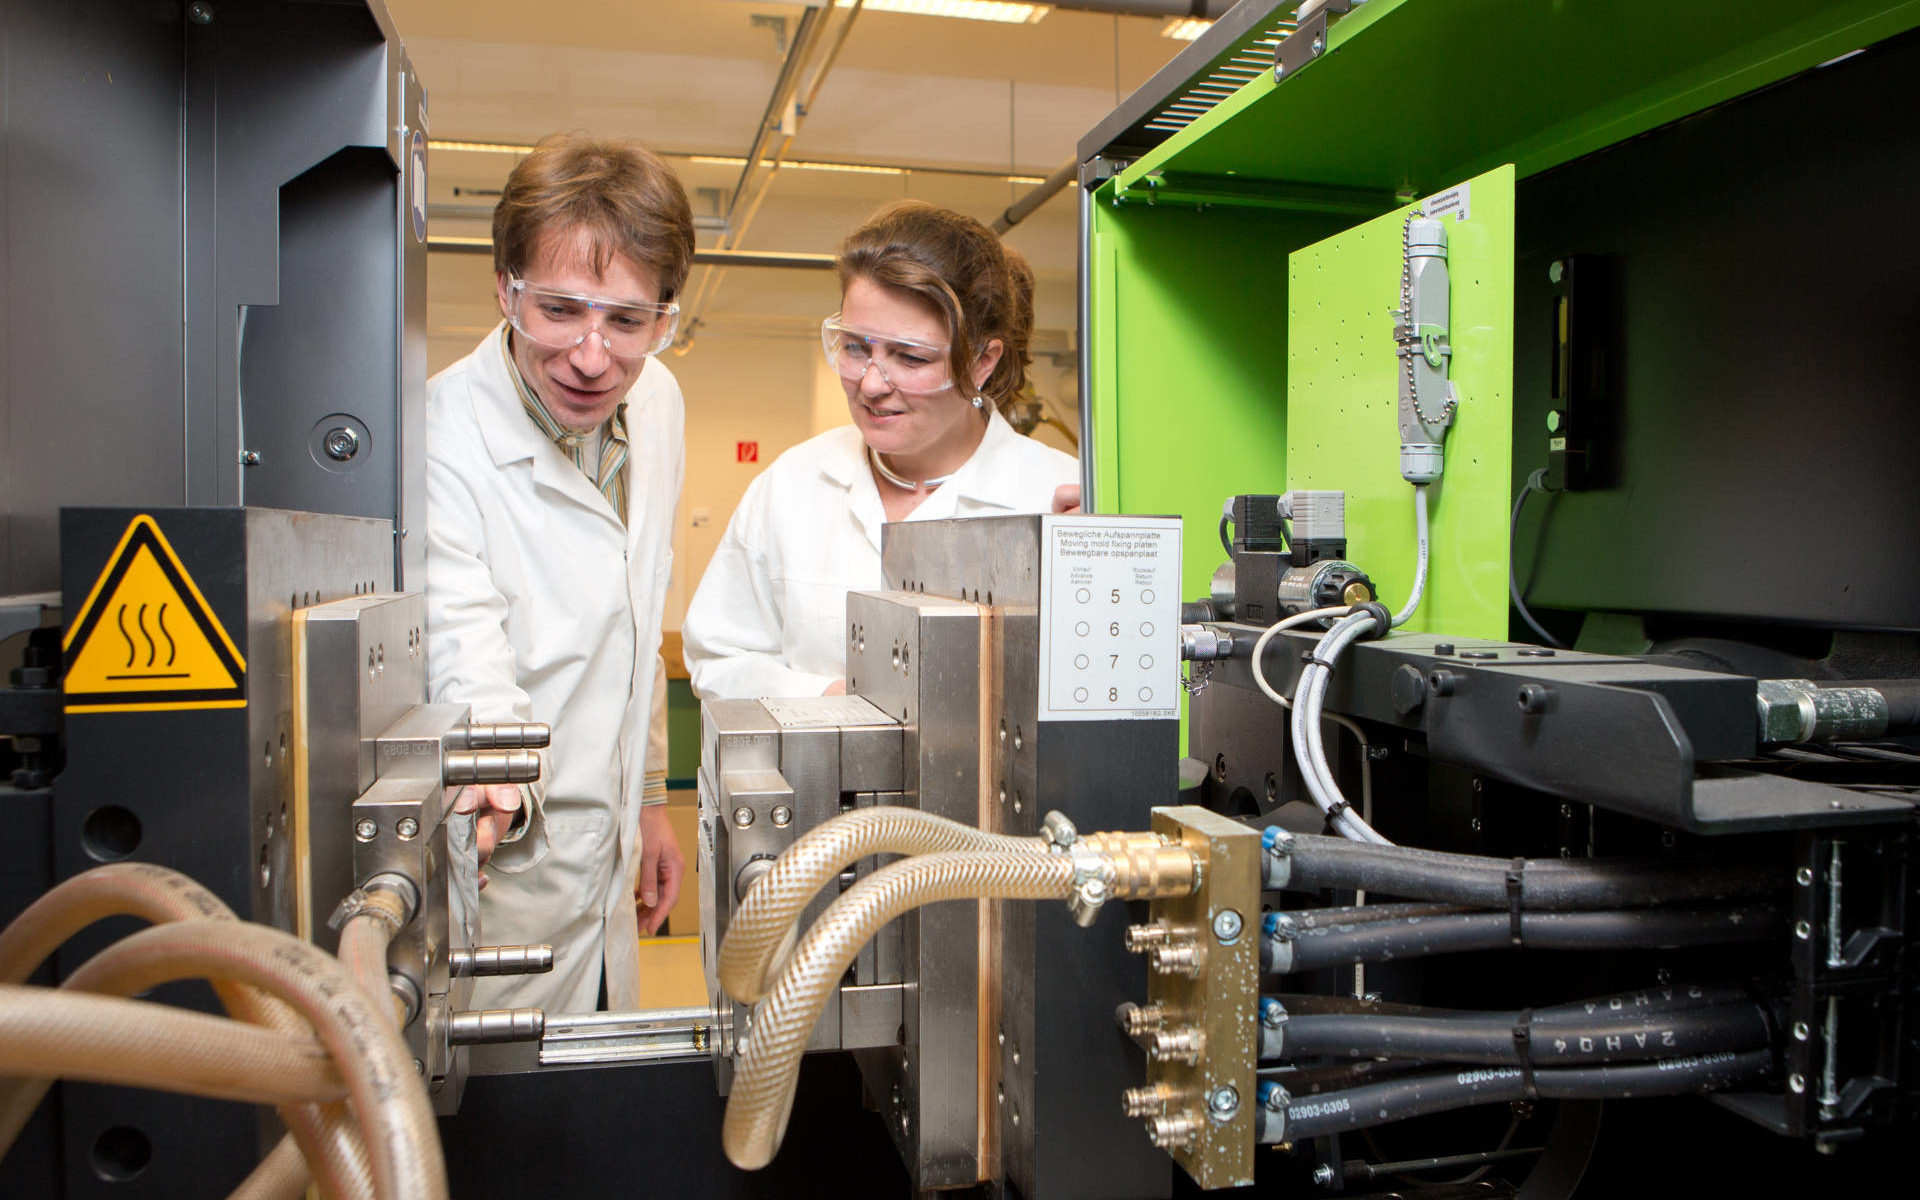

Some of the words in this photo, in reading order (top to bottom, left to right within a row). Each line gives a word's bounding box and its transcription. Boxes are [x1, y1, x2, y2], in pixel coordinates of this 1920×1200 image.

[1057, 529, 1102, 539] Bewegliche
[1104, 530, 1161, 539] Aufspannplatte
[1060, 540, 1088, 549] Moving
[1111, 540, 1132, 549] fixing
[1134, 541, 1157, 549] platen
[1060, 548, 1109, 558] Beweegbare
[1111, 588, 1120, 603] 5
[1109, 621, 1119, 636] 6
[1109, 654, 1119, 668] 7
[1108, 687, 1118, 702] 8
[1288, 1098, 1350, 1121] 02903-0305
